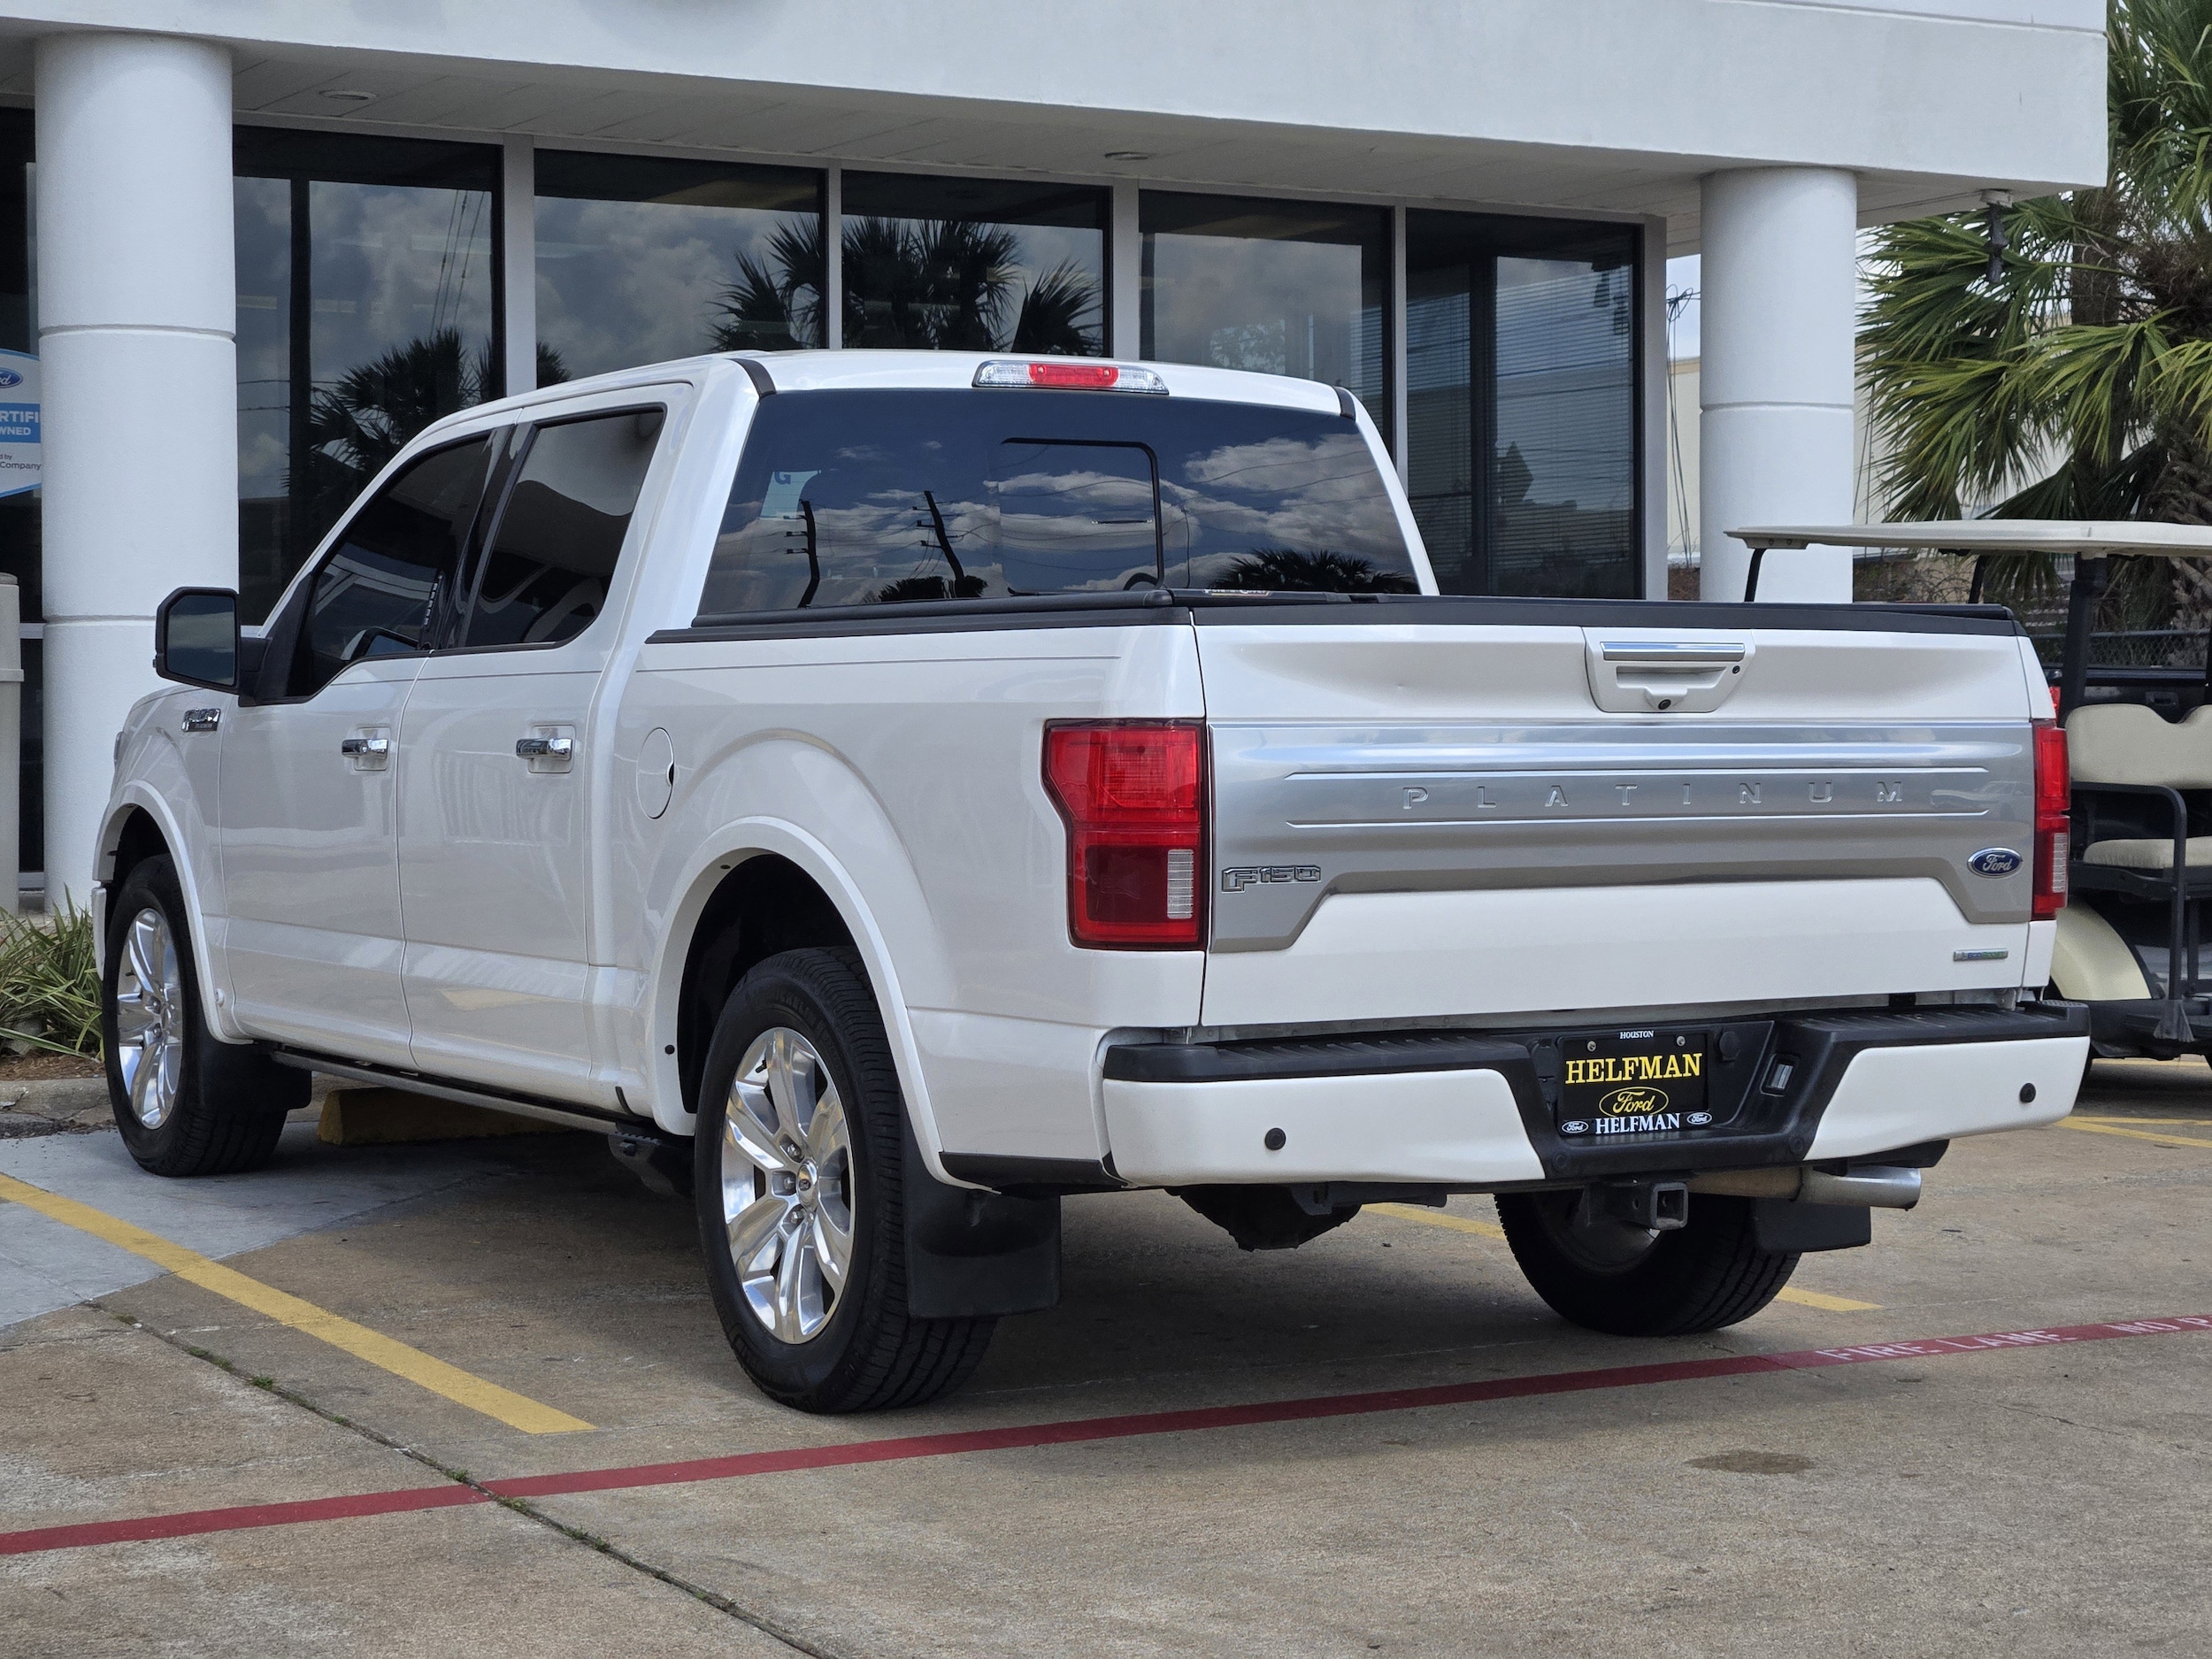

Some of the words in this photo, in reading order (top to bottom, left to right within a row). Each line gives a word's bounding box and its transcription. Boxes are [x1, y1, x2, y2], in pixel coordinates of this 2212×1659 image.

[0, 461, 42, 471] Company
[1402, 780, 1903, 810] PLATINUM
[1982, 853, 2013, 872] Ford
[1619, 1030, 1655, 1040] HOUSTON
[1564, 1052, 1703, 1085] HELFMAN
[1612, 1090, 1656, 1114] Ford
[1594, 1112, 1681, 1135] HELFMAN
[1815, 1341, 1943, 1361] FIRE
[1935, 1330, 2078, 1350] LANE
